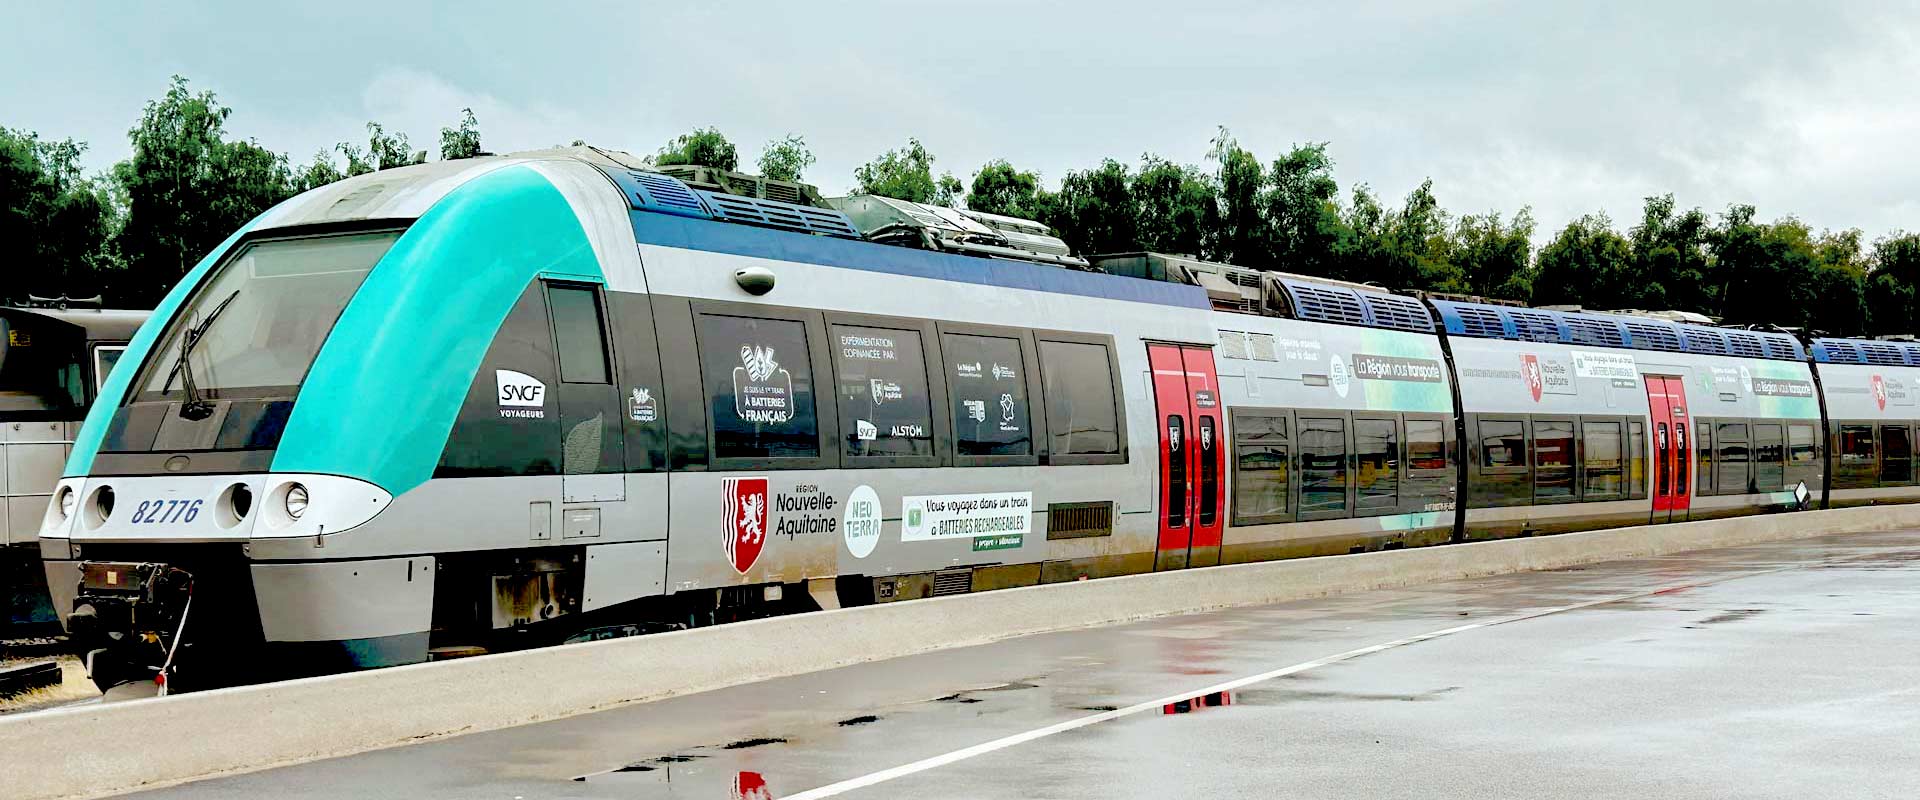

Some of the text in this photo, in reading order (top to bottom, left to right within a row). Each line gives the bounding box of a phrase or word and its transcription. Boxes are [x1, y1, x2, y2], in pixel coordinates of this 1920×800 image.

[883, 350, 895, 359] PAR
[1367, 358, 1391, 378] Région
[1407, 362, 1440, 380] transporte
[501, 384, 542, 401] SNCF
[745, 394, 785, 407] À BATTERIES
[500, 409, 544, 418] VOYAGEURS
[745, 409, 787, 425] FRANÇAIS
[796, 484, 818, 493] RÉGION
[776, 492, 838, 511] Nouvelle-
[852, 501, 872, 518] NEO
[926, 497, 1028, 515] Vous voyagez dans un train
[131, 499, 203, 523] 82776
[776, 514, 836, 541] Aquitaine
[846, 519, 879, 538] TERRA
[939, 518, 973, 535] BATTERIES
[974, 515, 1024, 532] RECHARGEABLES
